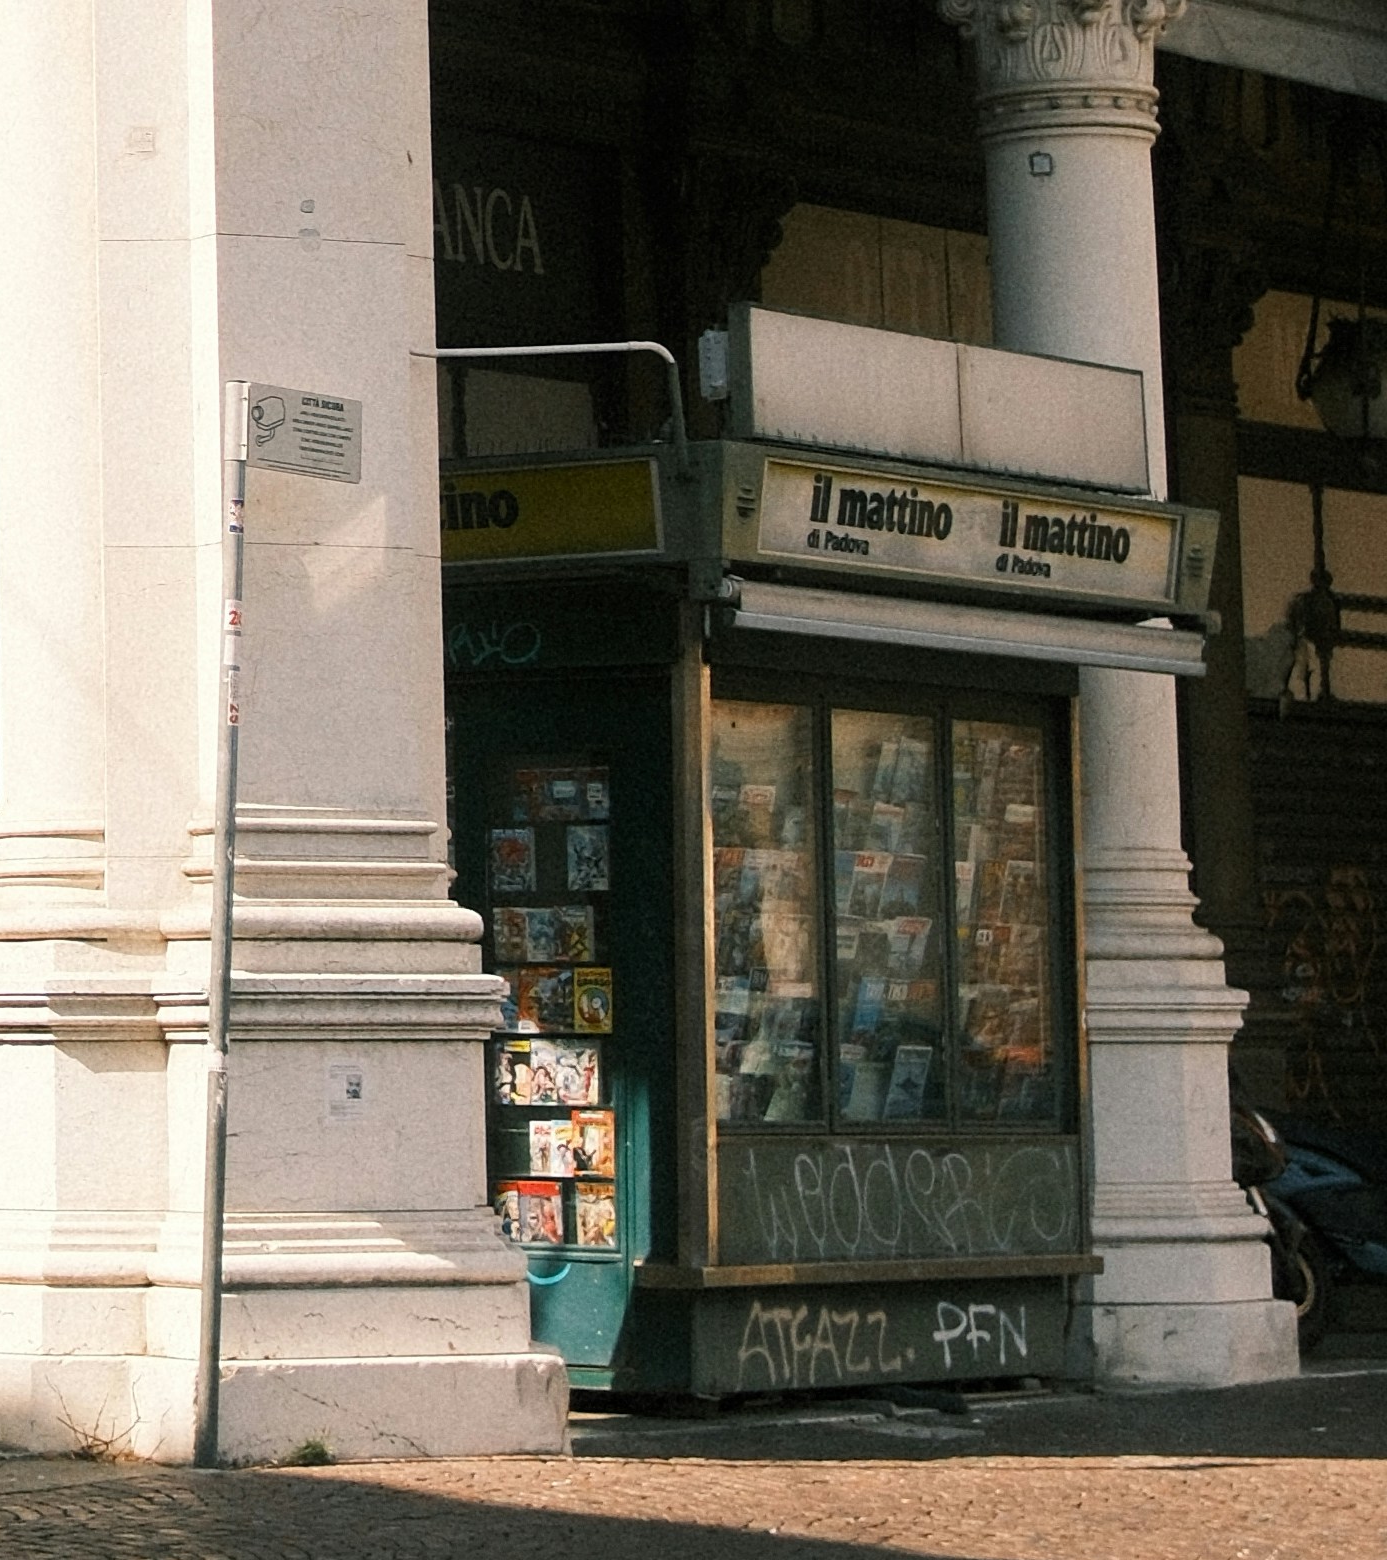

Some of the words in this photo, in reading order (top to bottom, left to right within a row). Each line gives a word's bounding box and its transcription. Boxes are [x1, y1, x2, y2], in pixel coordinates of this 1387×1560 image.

[440, 480, 519, 530] ino
[810, 472, 832, 523] il
[837, 488, 952, 540] mattino
[807, 529, 819, 550] di
[824, 530, 869, 555] Padova
[999, 500, 1019, 547] il
[1023, 513, 1130, 563] mattino
[996, 553, 1008, 572] di
[1011, 554, 1051, 578] Padova
